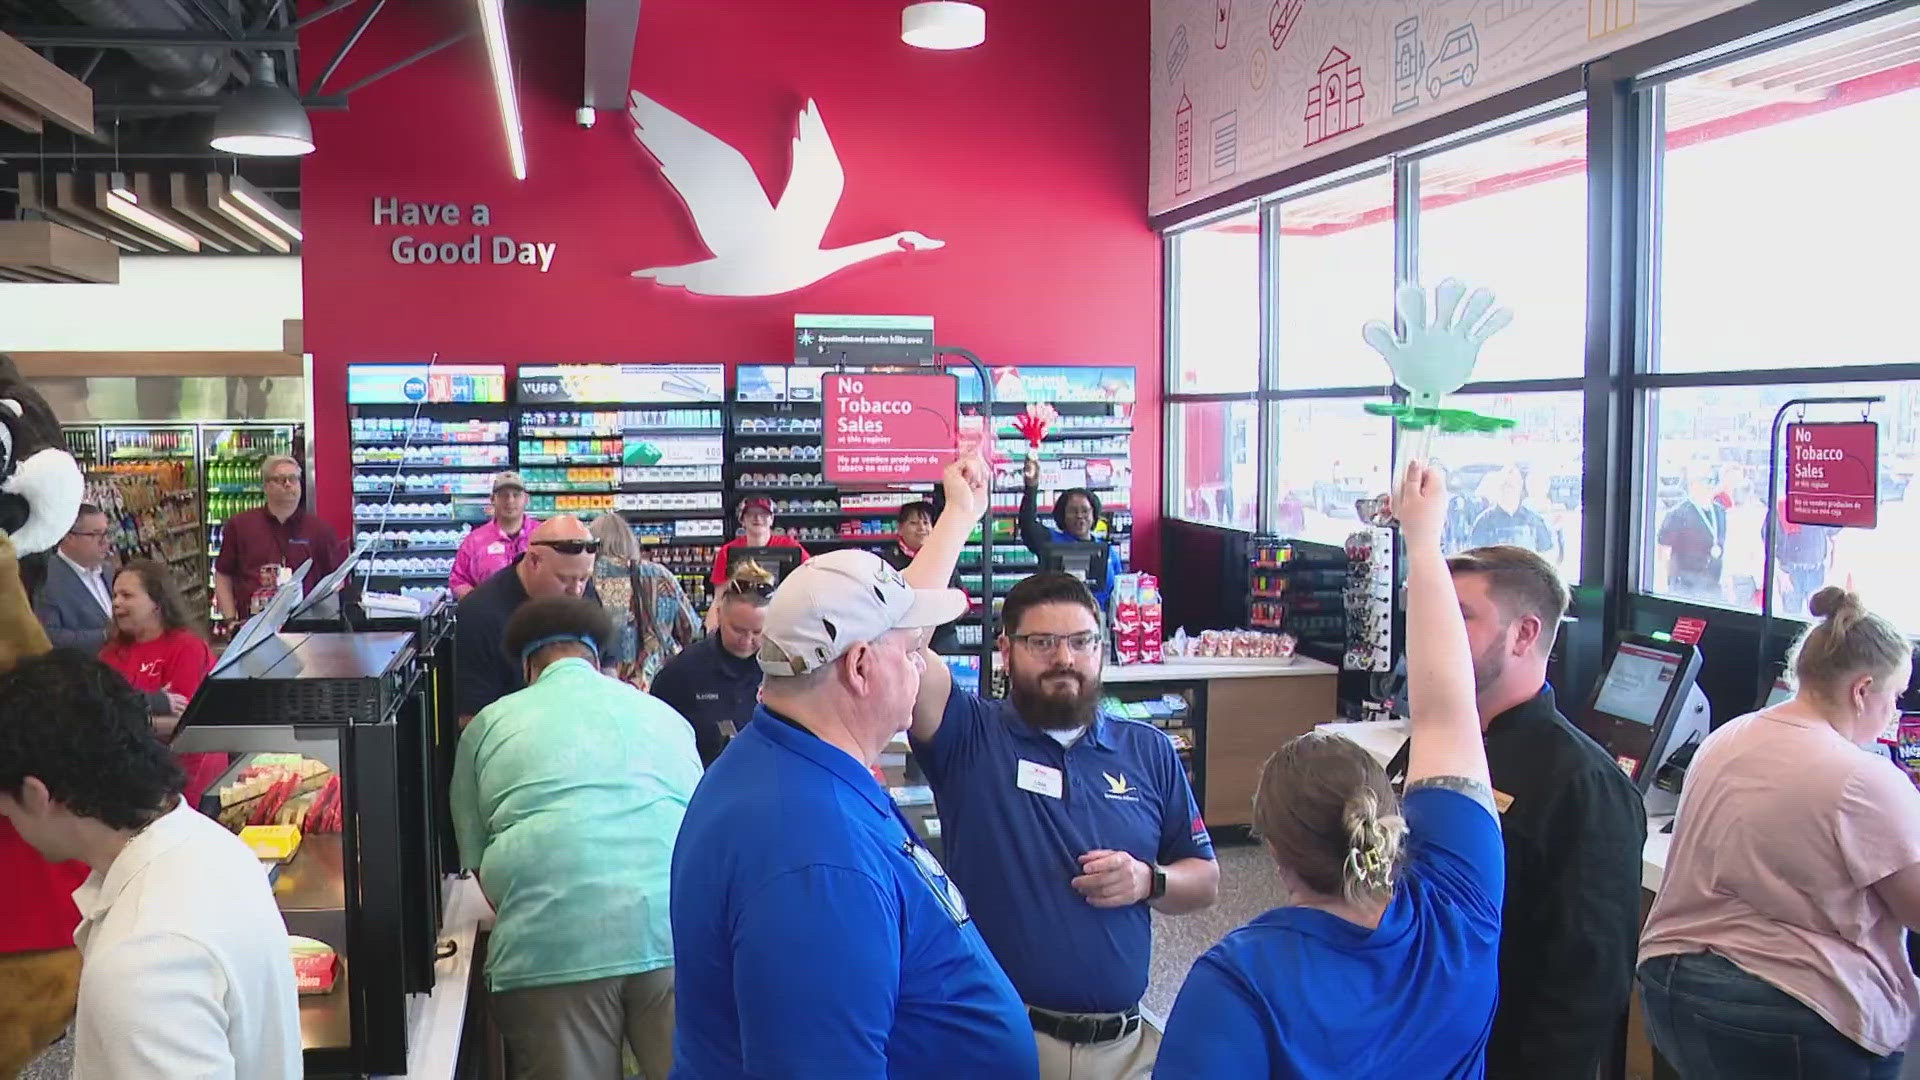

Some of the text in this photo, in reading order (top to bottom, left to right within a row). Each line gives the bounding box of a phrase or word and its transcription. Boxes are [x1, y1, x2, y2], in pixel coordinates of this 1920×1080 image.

[373, 197, 490, 227] Have a
[391, 235, 557, 273] Good Day
[837, 377, 864, 394] No
[837, 397, 913, 414] Tobacco
[837, 415, 883, 433] Sales
[1795, 427, 1812, 442] No
[1795, 446, 1843, 461] Tobacco
[1794, 463, 1824, 479] Sales
